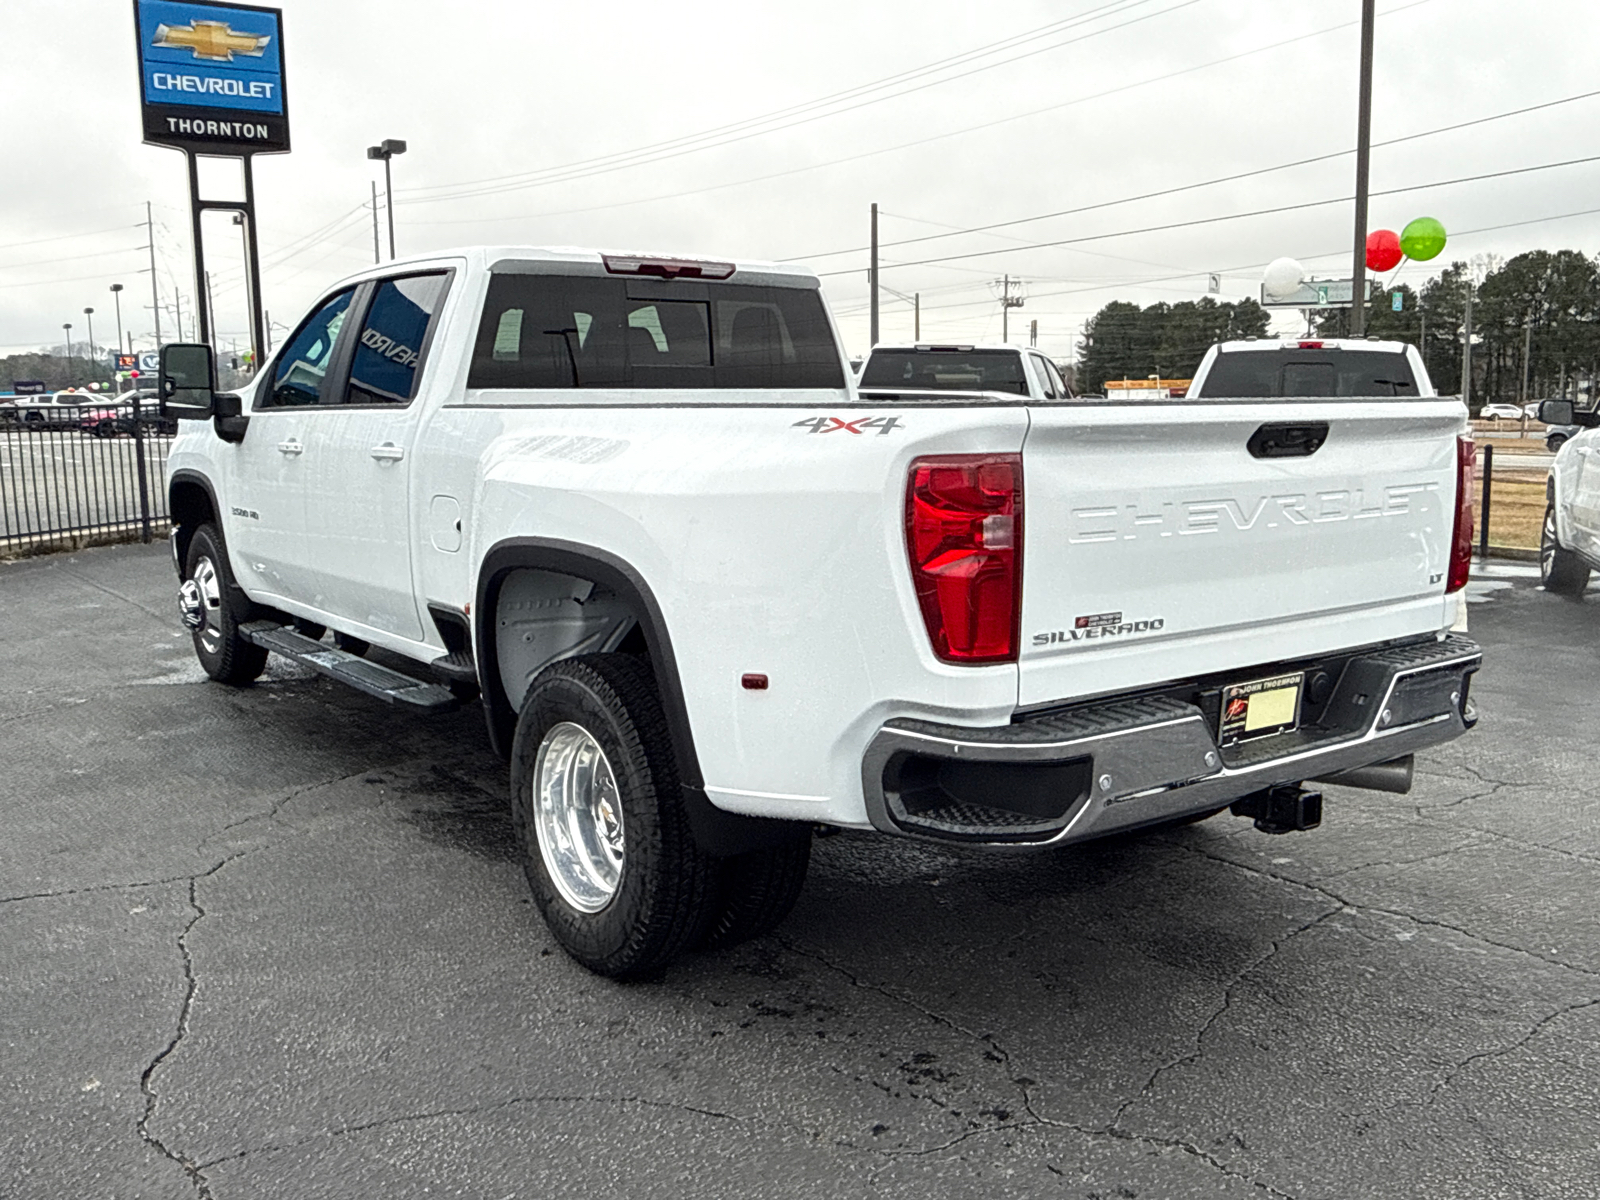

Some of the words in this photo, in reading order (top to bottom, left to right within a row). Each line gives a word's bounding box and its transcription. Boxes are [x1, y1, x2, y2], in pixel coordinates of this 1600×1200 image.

[153, 73, 274, 98] CHEVROLET
[166, 118, 268, 139] THORNTON
[1068, 481, 1439, 545] CHEVROLET
[1429, 572, 1445, 585] LT
[1032, 618, 1164, 646] SILVERADO
[1243, 683, 1263, 694] JOHN
